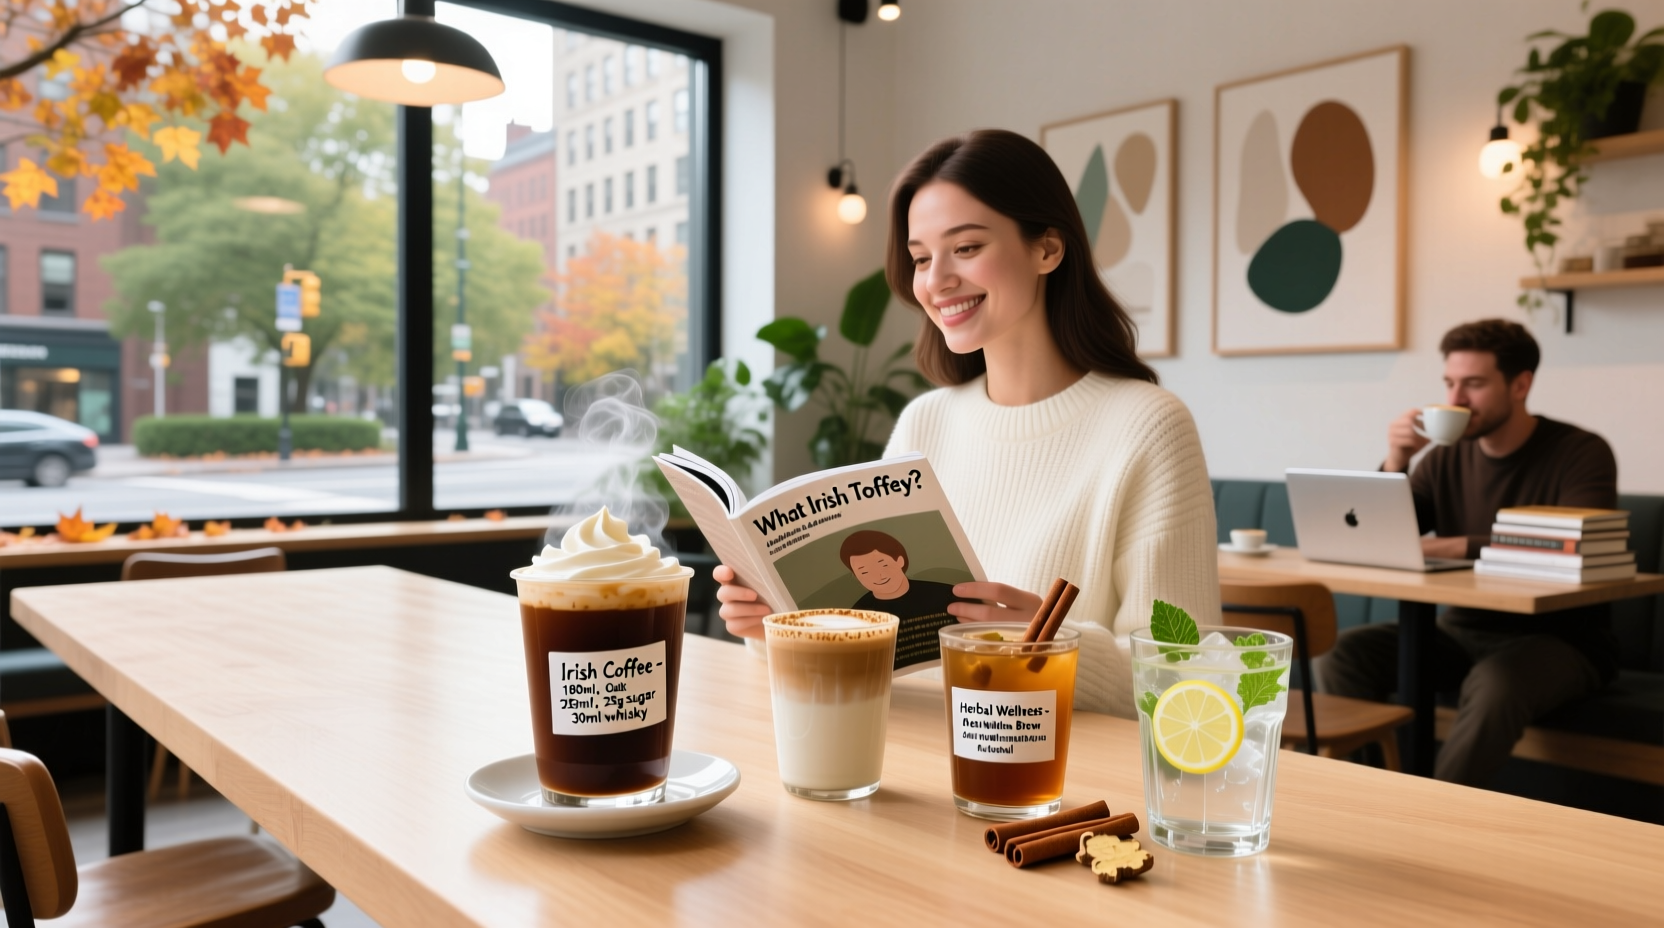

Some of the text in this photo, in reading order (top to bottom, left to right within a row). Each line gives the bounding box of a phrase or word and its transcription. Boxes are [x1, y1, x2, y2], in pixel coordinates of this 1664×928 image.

[753, 503, 807, 536] What
[806, 487, 849, 515] Irish
[848, 469, 922, 501] Toffey?
[561, 662, 597, 681] Irish
[603, 657, 653, 679] Coffee
[603, 696, 624, 709] 25g
[626, 690, 656, 705] sugar
[960, 702, 993, 716] Herbal
[571, 707, 648, 724] 30ml whisky
